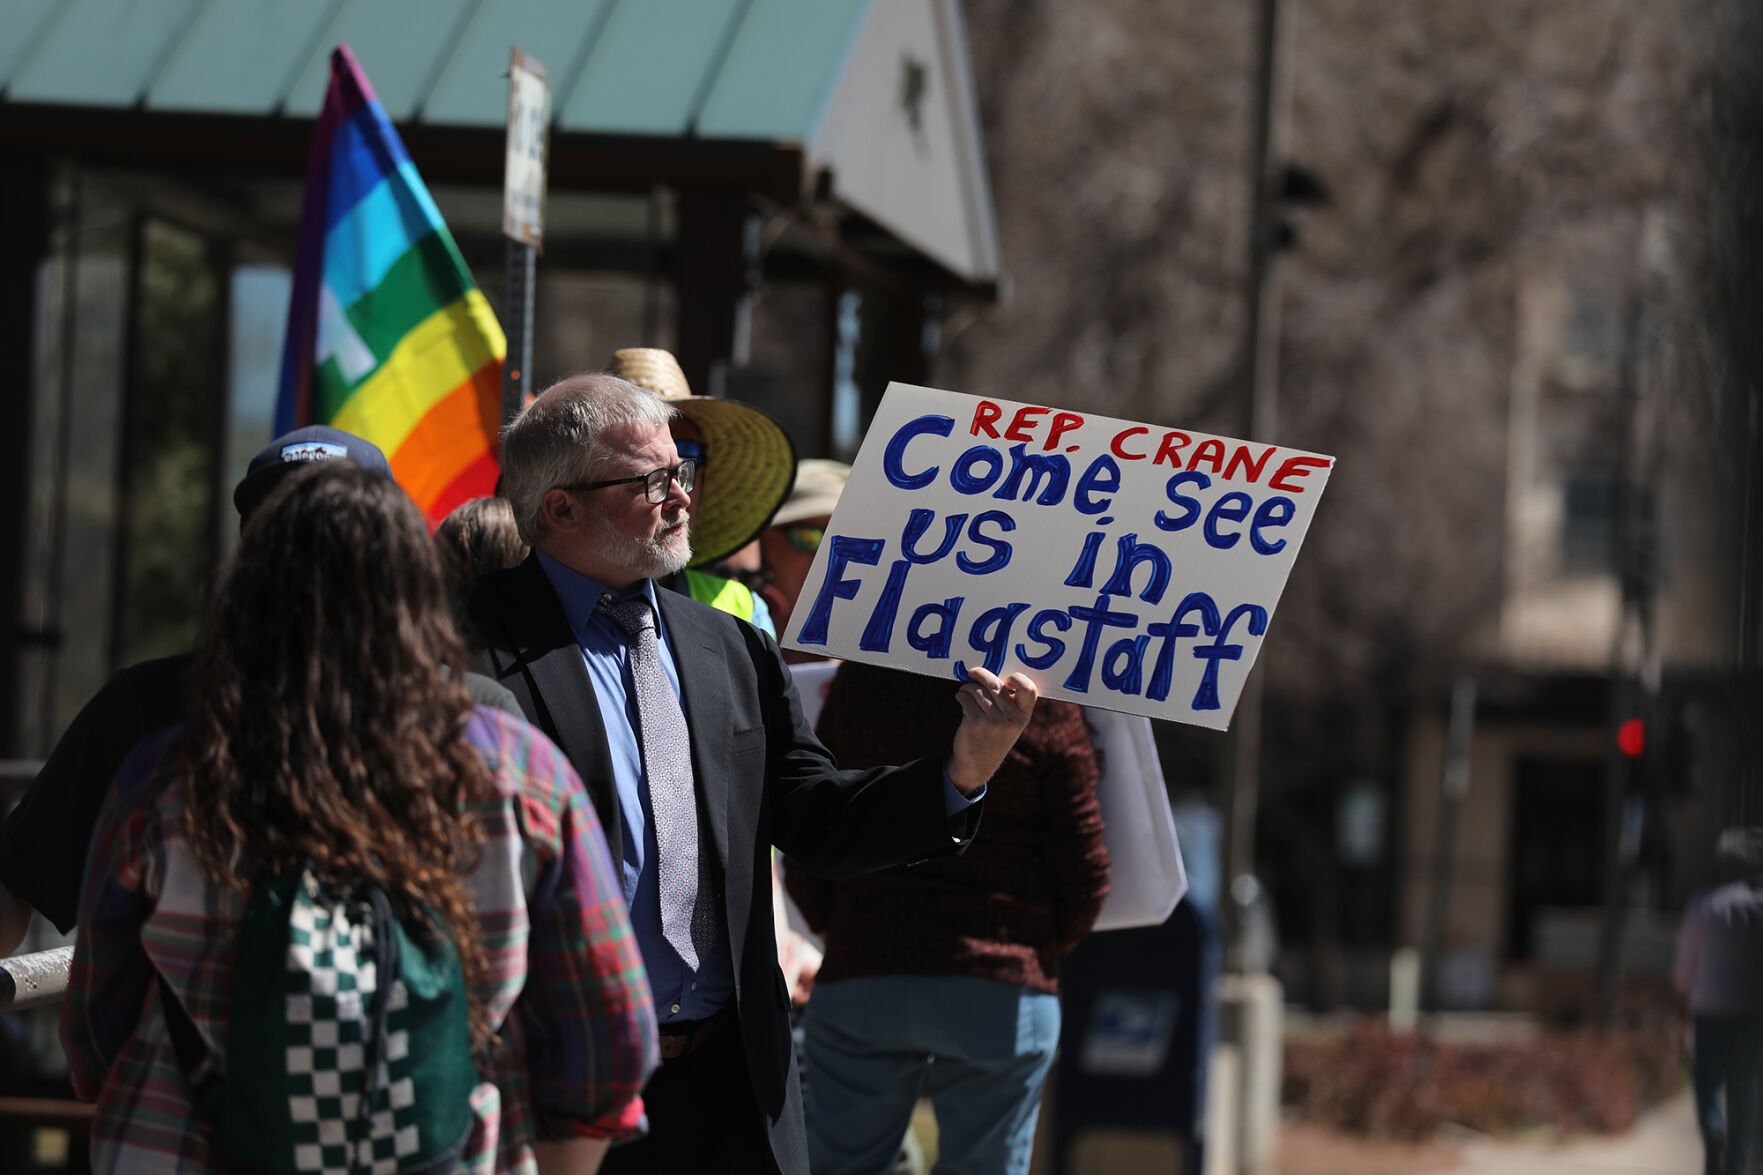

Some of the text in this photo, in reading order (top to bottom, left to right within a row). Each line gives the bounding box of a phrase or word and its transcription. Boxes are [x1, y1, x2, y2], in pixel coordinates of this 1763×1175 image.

[883, 414, 1121, 515] Come
[969, 399, 1332, 494] REP. CRANE
[1064, 516, 1173, 606] in
[796, 535, 1269, 711] Flagstaff
